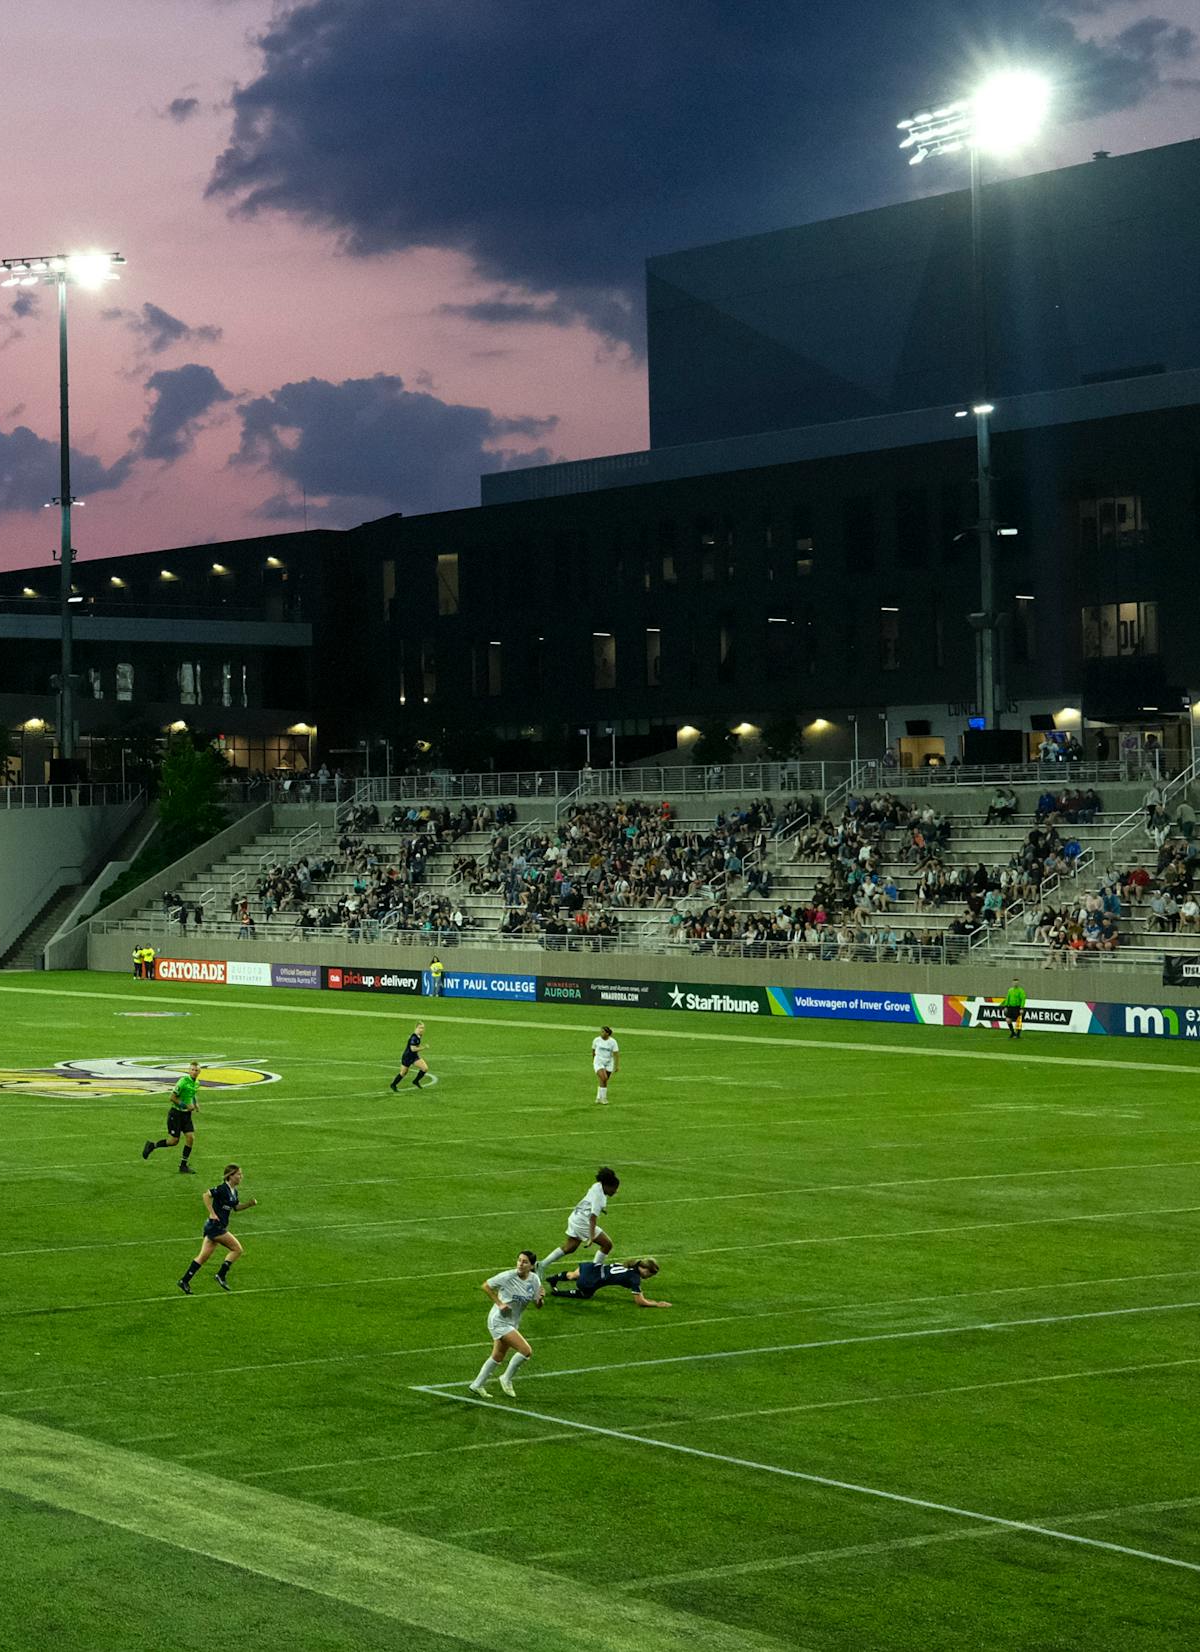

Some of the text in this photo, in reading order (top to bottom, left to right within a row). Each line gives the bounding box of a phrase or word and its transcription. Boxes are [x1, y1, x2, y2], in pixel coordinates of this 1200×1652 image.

[159, 961, 225, 981] GATORADE
[463, 979, 488, 990] PAUL
[491, 981, 536, 993] COLLEGE
[544, 988, 581, 999] AURORA
[686, 993, 760, 1013] StarTribune
[795, 996, 910, 1012] Volkswagen of Inver Grove
[983, 1009, 1066, 1022] MALL AMERICA
